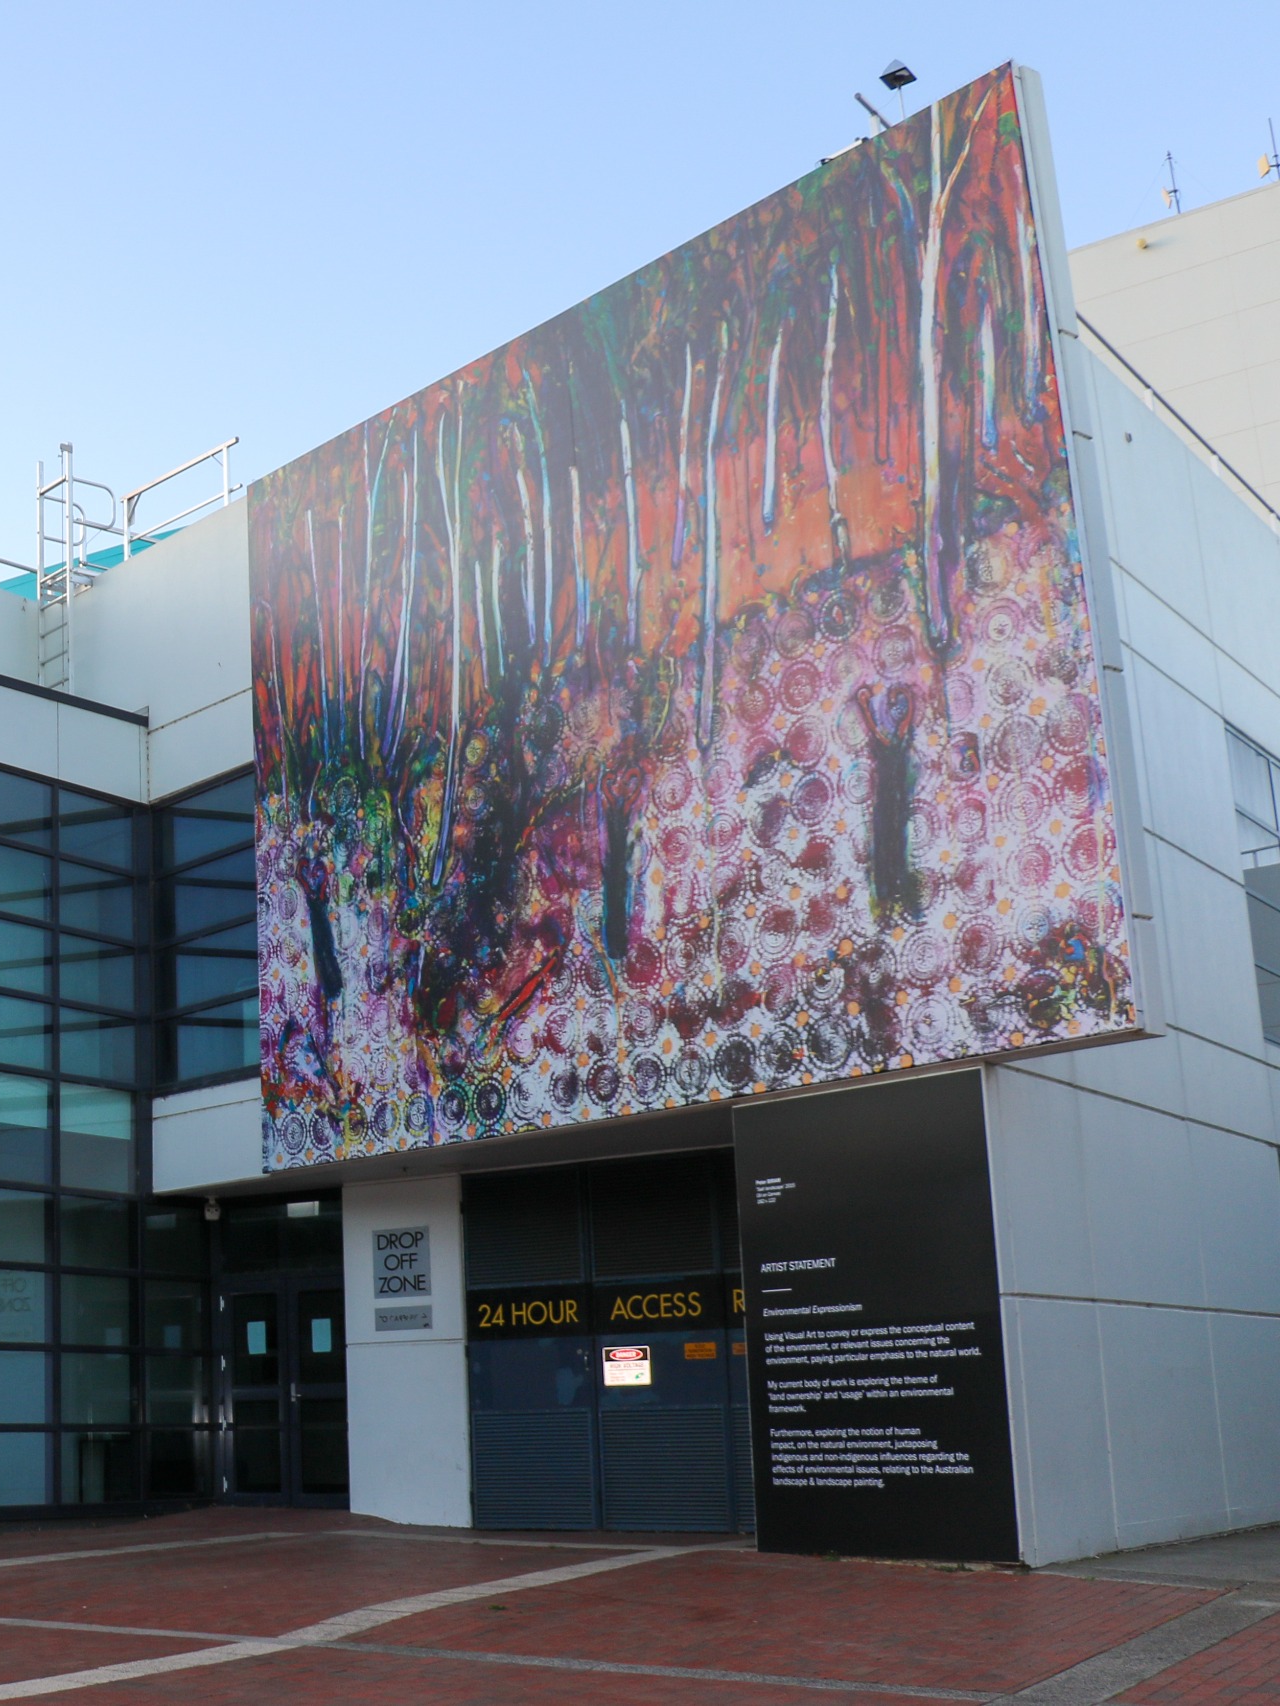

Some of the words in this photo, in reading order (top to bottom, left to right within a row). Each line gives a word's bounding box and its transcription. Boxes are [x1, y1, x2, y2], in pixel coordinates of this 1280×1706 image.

[376, 1231, 424, 1251] DROP
[384, 1253, 418, 1271] OFF
[760, 1262, 788, 1273] ARTIST
[788, 1258, 836, 1271] STATEMENT
[378, 1274, 426, 1294] ZONE
[478, 1304, 505, 1327] 24
[511, 1299, 579, 1326] HOUR
[610, 1291, 702, 1321] ACCESS
[763, 1305, 811, 1317] Environmental
[812, 1303, 862, 1314] Expressionism
[764, 1332, 784, 1342] Using
[784, 1331, 805, 1340] Visual
[806, 1331, 817, 1339] Art
[817, 1330, 825, 1338] to
[825, 1330, 850, 1339] convey
[860, 1328, 888, 1337] express
[888, 1326, 901, 1334] the
[902, 1323, 944, 1334] conceptual
[944, 1322, 975, 1331] content
[765, 1345, 772, 1353] of
[773, 1344, 785, 1353] the
[785, 1342, 830, 1352] environment,
[831, 1342, 839, 1350] or
[840, 1341, 869, 1349] relevant
[870, 1340, 894, 1348] issues
[894, 1337, 936, 1347] concerning
[936, 1336, 950, 1345] the
[766, 1356, 810, 1365] environment,
[810, 1354, 834, 1364] paying
[834, 1353, 868, 1363] particular
[870, 1351, 905, 1361] emphasis
[906, 1351, 914, 1359] to
[915, 1350, 928, 1358] the
[929, 1348, 957, 1357] natural
[958, 1347, 982, 1356] world.
[767, 1380, 778, 1390] My
[779, 1380, 803, 1388] current
[804, 1379, 820, 1389] body
[822, 1378, 830, 1387] of
[831, 1378, 848, 1386] work
[848, 1378, 856, 1386] is
[856, 1377, 890, 1387] exploring
[890, 1376, 903, 1385] the
[904, 1376, 928, 1384] theme
[929, 1374, 938, 1383] of
[823, 1391, 839, 1399] and
[865, 1389, 888, 1398] within
[889, 1390, 899, 1398] an
[900, 1387, 954, 1397] environmental
[768, 1404, 807, 1413] framework.
[769, 1428, 814, 1438] Furthermore,
[814, 1428, 848, 1438] exploring
[848, 1427, 860, 1436] the
[860, 1427, 884, 1436] notion
[885, 1427, 893, 1435] of
[894, 1427, 921, 1435] human
[771, 1441, 796, 1451] impact,
[796, 1441, 806, 1449] on
[807, 1441, 819, 1449] the
[820, 1440, 846, 1449] natural
[846, 1440, 893, 1449] environment,
[894, 1439, 938, 1450] juxtaposing
[771, 1453, 809, 1463] indigenous
[809, 1453, 823, 1461] and
[824, 1452, 879, 1463] non-indigenous
[880, 1452, 918, 1461] influences
[918, 1452, 956, 1463] regarding
[956, 1451, 970, 1461] the
[772, 1465, 796, 1474] effects
[796, 1465, 804, 1473] of
[804, 1465, 855, 1473] environmental
[855, 1465, 881, 1474] issues,
[882, 1465, 912, 1476] relating
[911, 1465, 919, 1474] to
[920, 1465, 933, 1473] the
[935, 1464, 974, 1474] Australian
[772, 1477, 808, 1487] landscape
[809, 1477, 816, 1486] &
[816, 1477, 853, 1487] landscape
[853, 1477, 885, 1488] painting.
